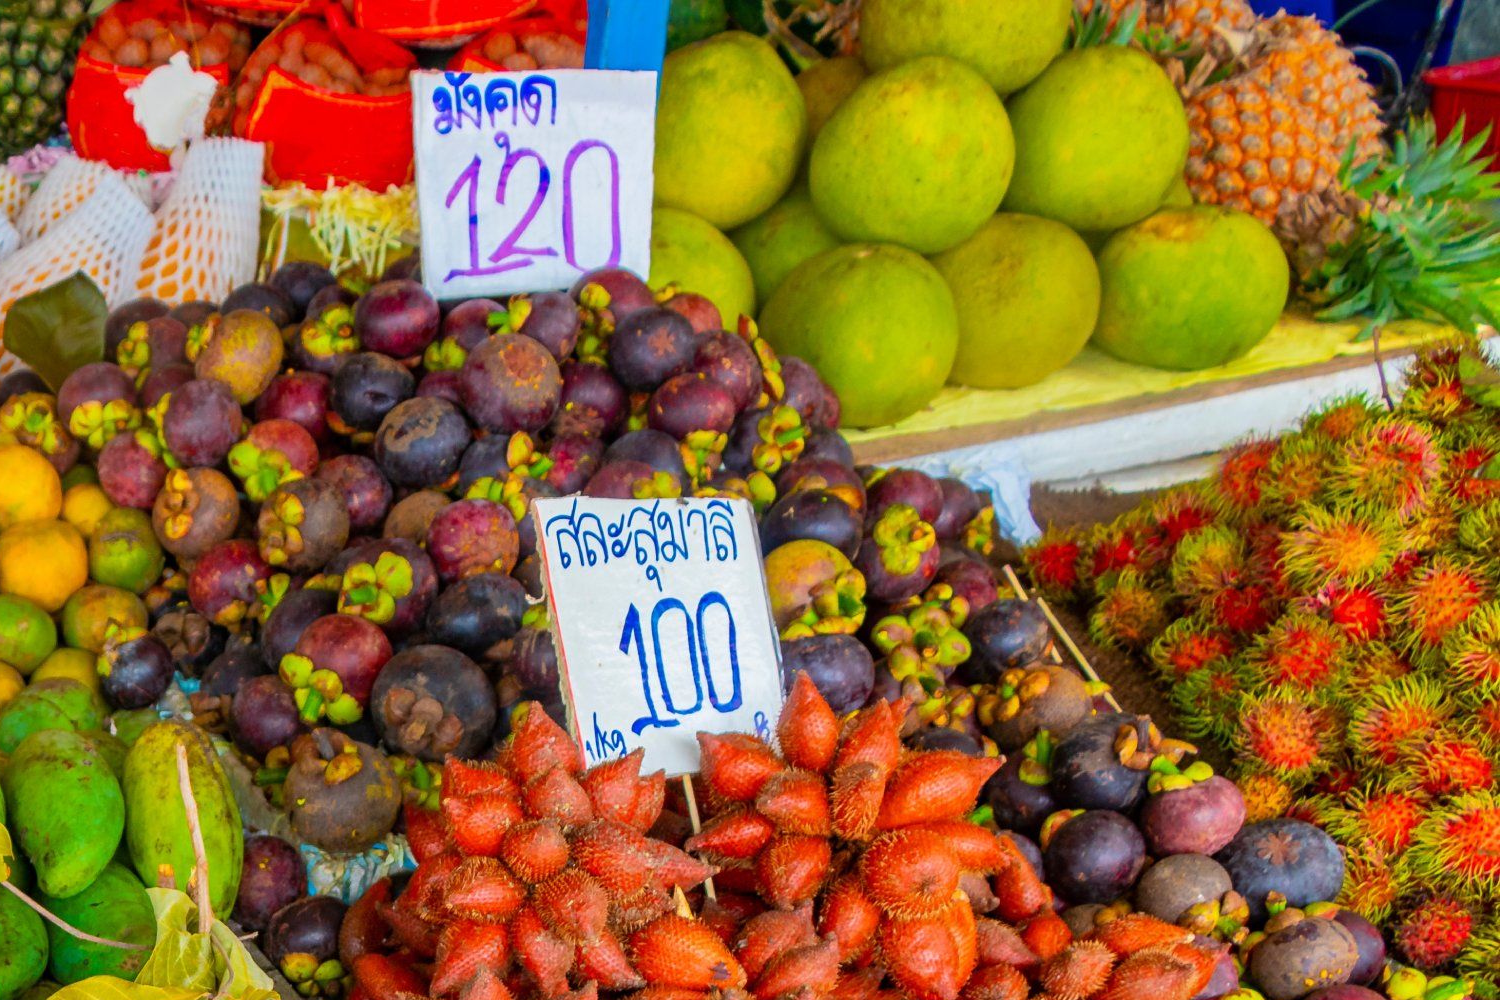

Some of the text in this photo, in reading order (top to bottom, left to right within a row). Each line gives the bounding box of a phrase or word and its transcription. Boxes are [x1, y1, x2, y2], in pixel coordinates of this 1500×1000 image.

[443, 138, 622, 283] 120
[546, 498, 738, 592] สละสุมาลี
[619, 590, 743, 736] 100
